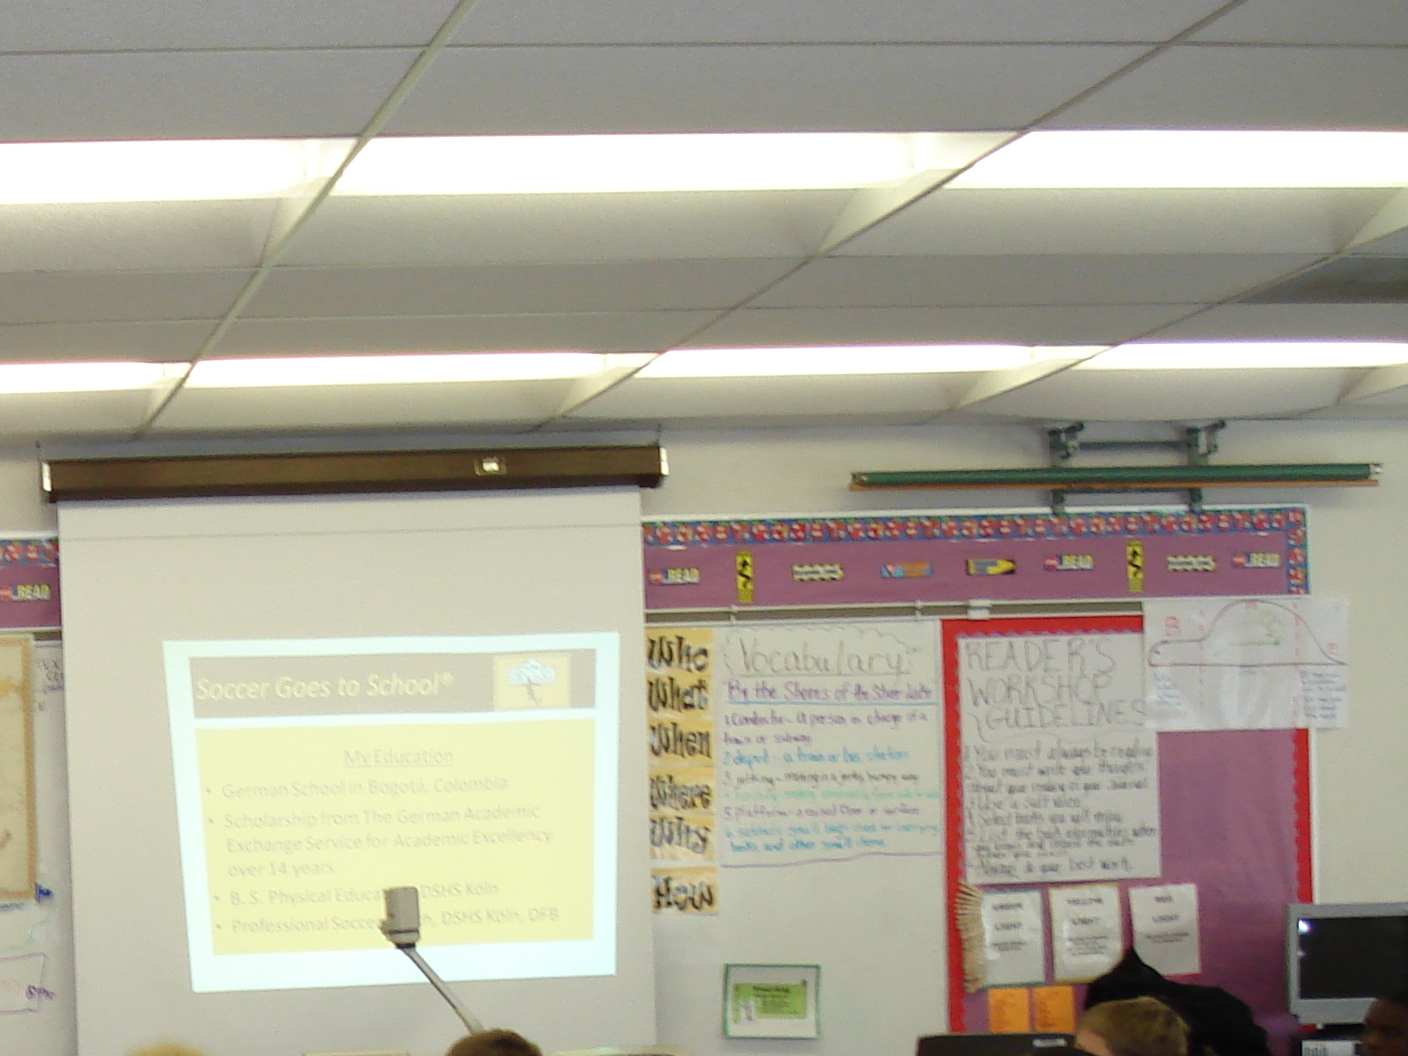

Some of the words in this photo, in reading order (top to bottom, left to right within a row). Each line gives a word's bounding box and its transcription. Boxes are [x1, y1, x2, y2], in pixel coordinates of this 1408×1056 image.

[18, 584, 51, 600] READ
[647, 635, 709, 674] Who
[737, 637, 904, 684] Vocabulary
[195, 678, 271, 701] Soccer
[274, 676, 332, 699] Goes
[338, 676, 361, 697] to
[647, 676, 709, 713] What
[985, 699, 1148, 730] GUIDELINES
[649, 722, 712, 760] When
[343, 750, 369, 768] My
[374, 749, 454, 767] Education
[221, 783, 289, 799] German
[290, 780, 346, 798] School
[349, 780, 364, 795] in
[432, 774, 508, 794] Colombia
[649, 774, 712, 811] Where
[223, 811, 317, 831] Scholarship
[320, 810, 360, 827] from
[363, 808, 392, 826] The
[395, 807, 461, 826] German
[463, 802, 540, 822] Academic
[226, 837, 303, 856] Exchange
[305, 835, 362, 853] Service
[366, 833, 389, 850] for
[392, 830, 469, 849] Academic
[471, 827, 554, 846] Excellency
[650, 815, 711, 855] Why
[227, 864, 265, 879] over
[267, 861, 288, 878] 14
[291, 864, 335, 882] years
[268, 887, 333, 907] Physical
[420, 883, 463, 900] DSHS
[465, 881, 499, 898] Köln
[653, 875, 715, 912] How
[231, 915, 329, 934] Professional
[331, 913, 381, 931] Socce
[440, 909, 483, 927] DSHS
[527, 906, 559, 923] DFB
